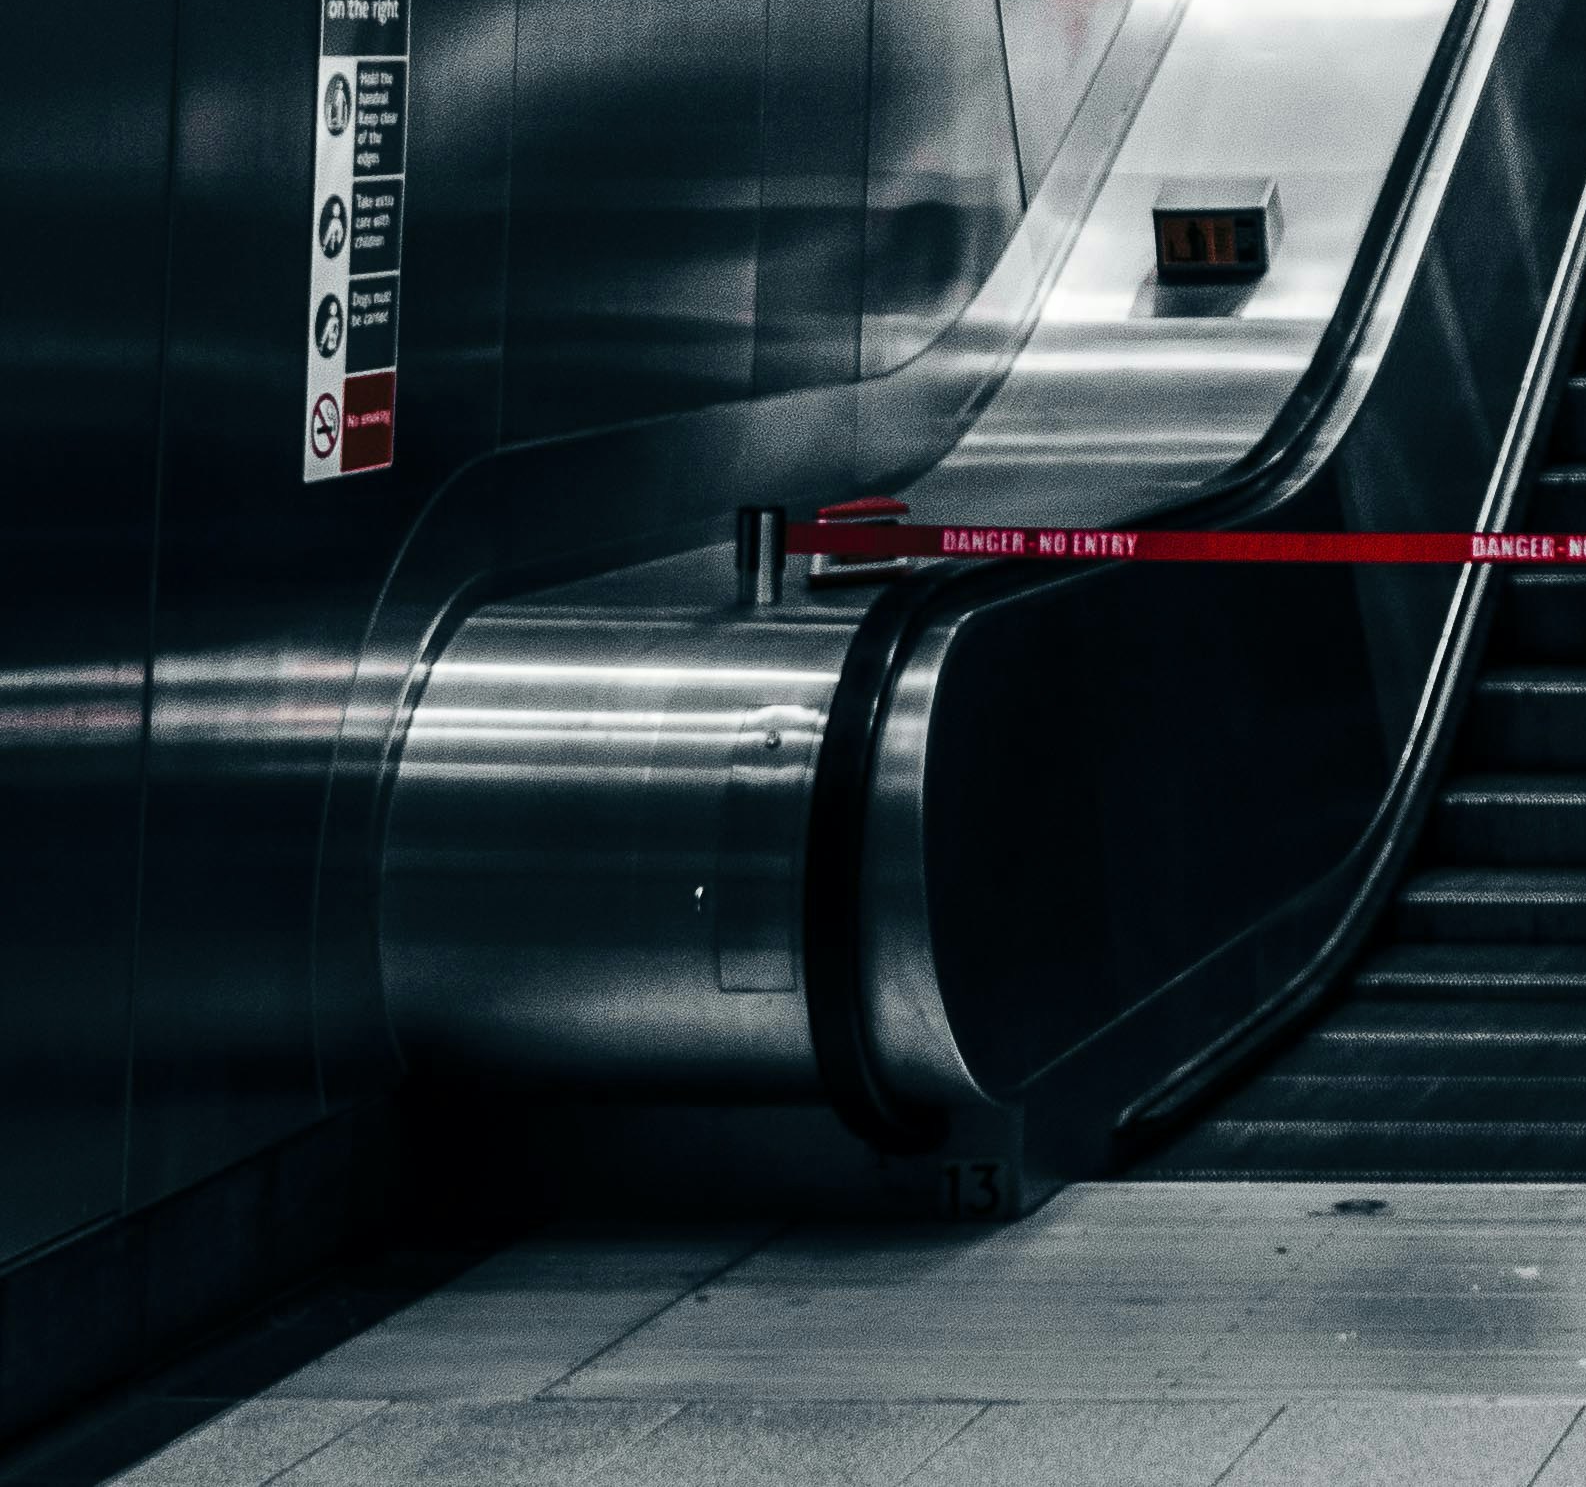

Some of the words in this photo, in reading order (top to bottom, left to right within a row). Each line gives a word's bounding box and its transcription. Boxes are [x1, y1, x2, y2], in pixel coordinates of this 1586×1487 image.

[327, 0, 346, 19] on
[943, 529, 1025, 555] DANGER
[1039, 532, 1067, 554] NO
[1072, 532, 1138, 557] ENTRY
[1472, 534, 1555, 558] DANGER
[945, 1163, 1000, 1219] 13
